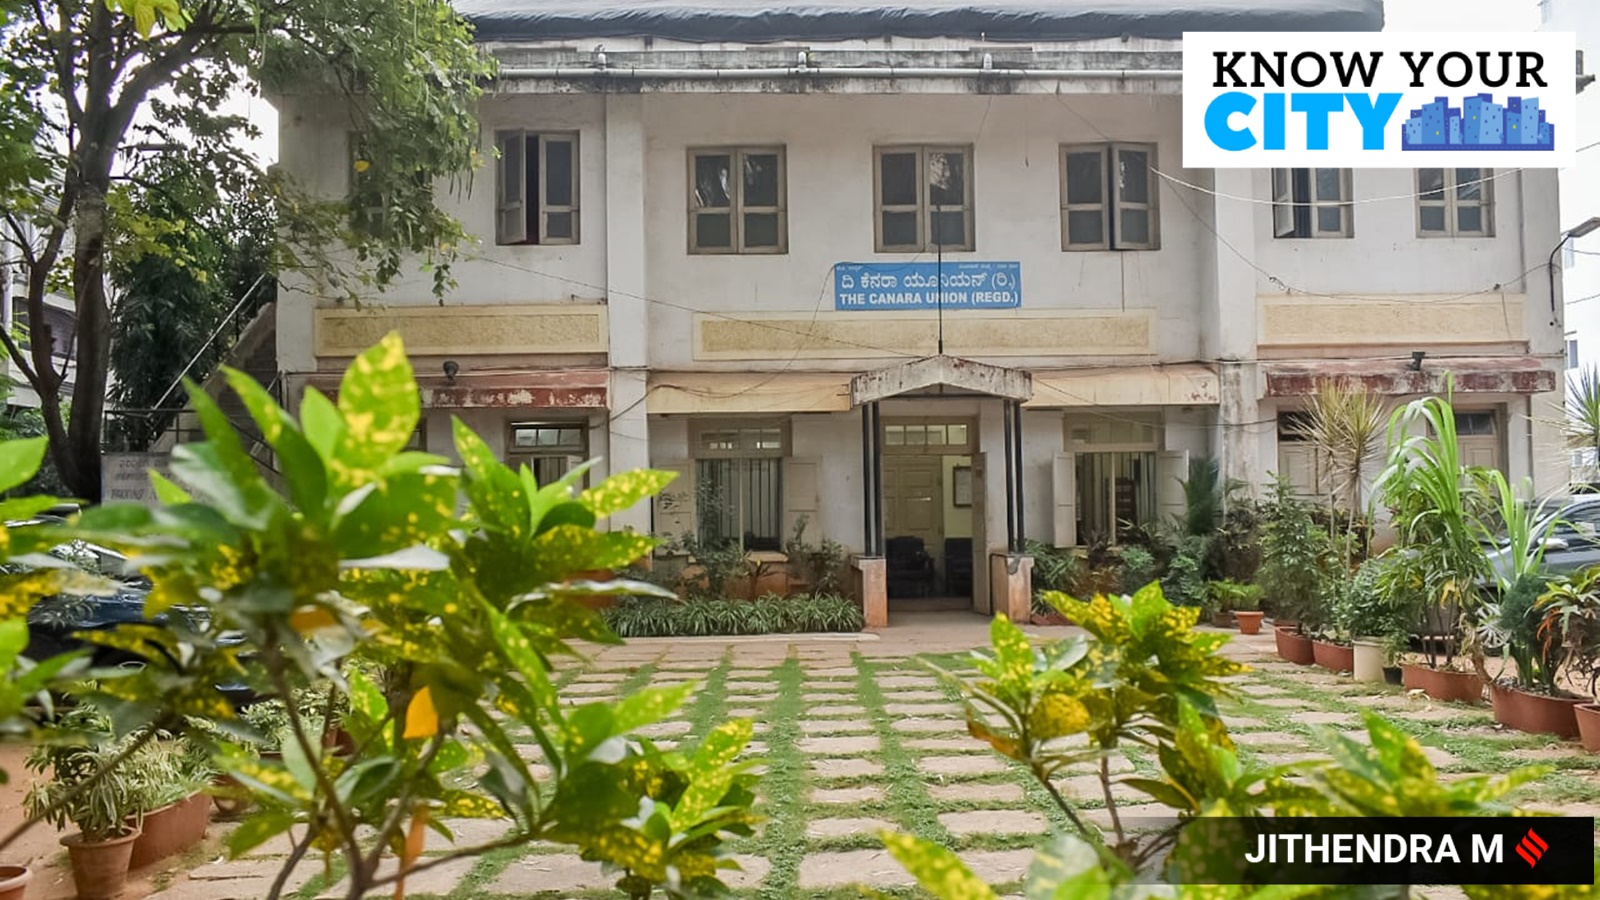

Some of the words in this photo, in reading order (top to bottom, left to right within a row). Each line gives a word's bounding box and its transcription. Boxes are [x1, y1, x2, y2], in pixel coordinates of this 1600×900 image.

[841, 273, 855, 289] ದಿ
[860, 272, 898, 288] ಕೆನರಾ
[839, 293, 865, 305] THE
[869, 292, 922, 305] CANARA
[925, 291, 968, 304] UNION
[971, 291, 1018, 306] (REGD.)
